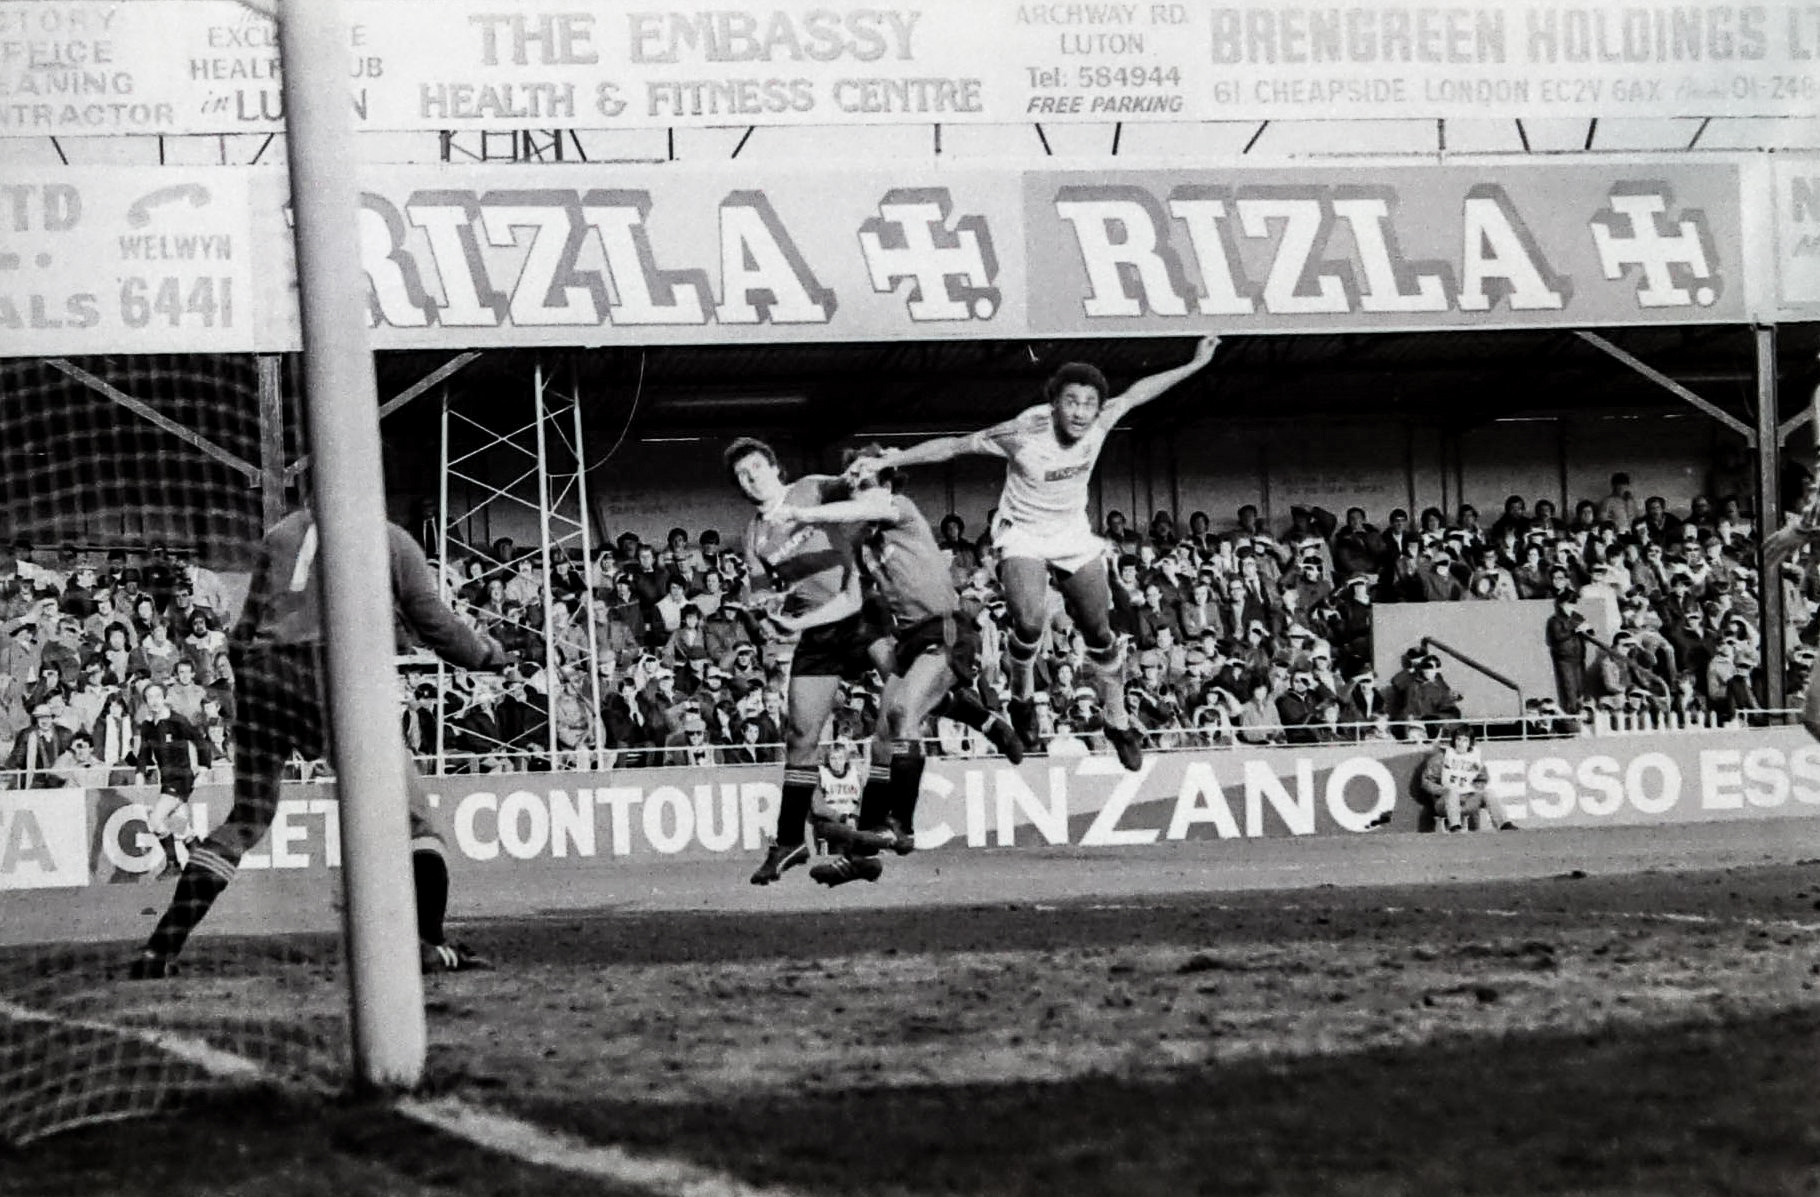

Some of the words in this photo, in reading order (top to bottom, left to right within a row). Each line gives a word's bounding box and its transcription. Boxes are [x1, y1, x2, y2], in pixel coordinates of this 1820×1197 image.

[0, 9, 116, 32] TORY
[1016, 4, 1138, 25] ARCHWAY
[468, 12, 600, 66] THE
[626, 9, 922, 64] EMBASSY
[1060, 32, 1145, 55] LUTON
[1211, 8, 1505, 64] BRENGREEN
[1526, 6, 1767, 63] HOLDINGS
[190, 57, 283, 80] HEALT
[1078, 65, 1182, 88] 584944
[201, 91, 229, 114] in
[419, 82, 576, 118] HEALTH
[595, 82, 628, 117] &
[646, 79, 815, 116] FITNESS
[832, 78, 984, 113] CENTRE
[1026, 95, 1084, 114] FREE
[1090, 95, 1184, 113] PARKING
[1255, 78, 1406, 103] CHEAPSIDE
[1425, 79, 1529, 104] LONDON
[1540, 79, 1602, 102] EC2V
[118, 234, 232, 261] WELWYN
[357, 188, 838, 327] RIZLA
[1055, 184, 1575, 317] RIZLA
[119, 276, 233, 329] 6441
[1485, 751, 1682, 819] ESSO
[1701, 744, 1820, 810] ESS
[454, 781, 782, 861] CONTOUR
[913, 756, 1397, 850] CINZANO
